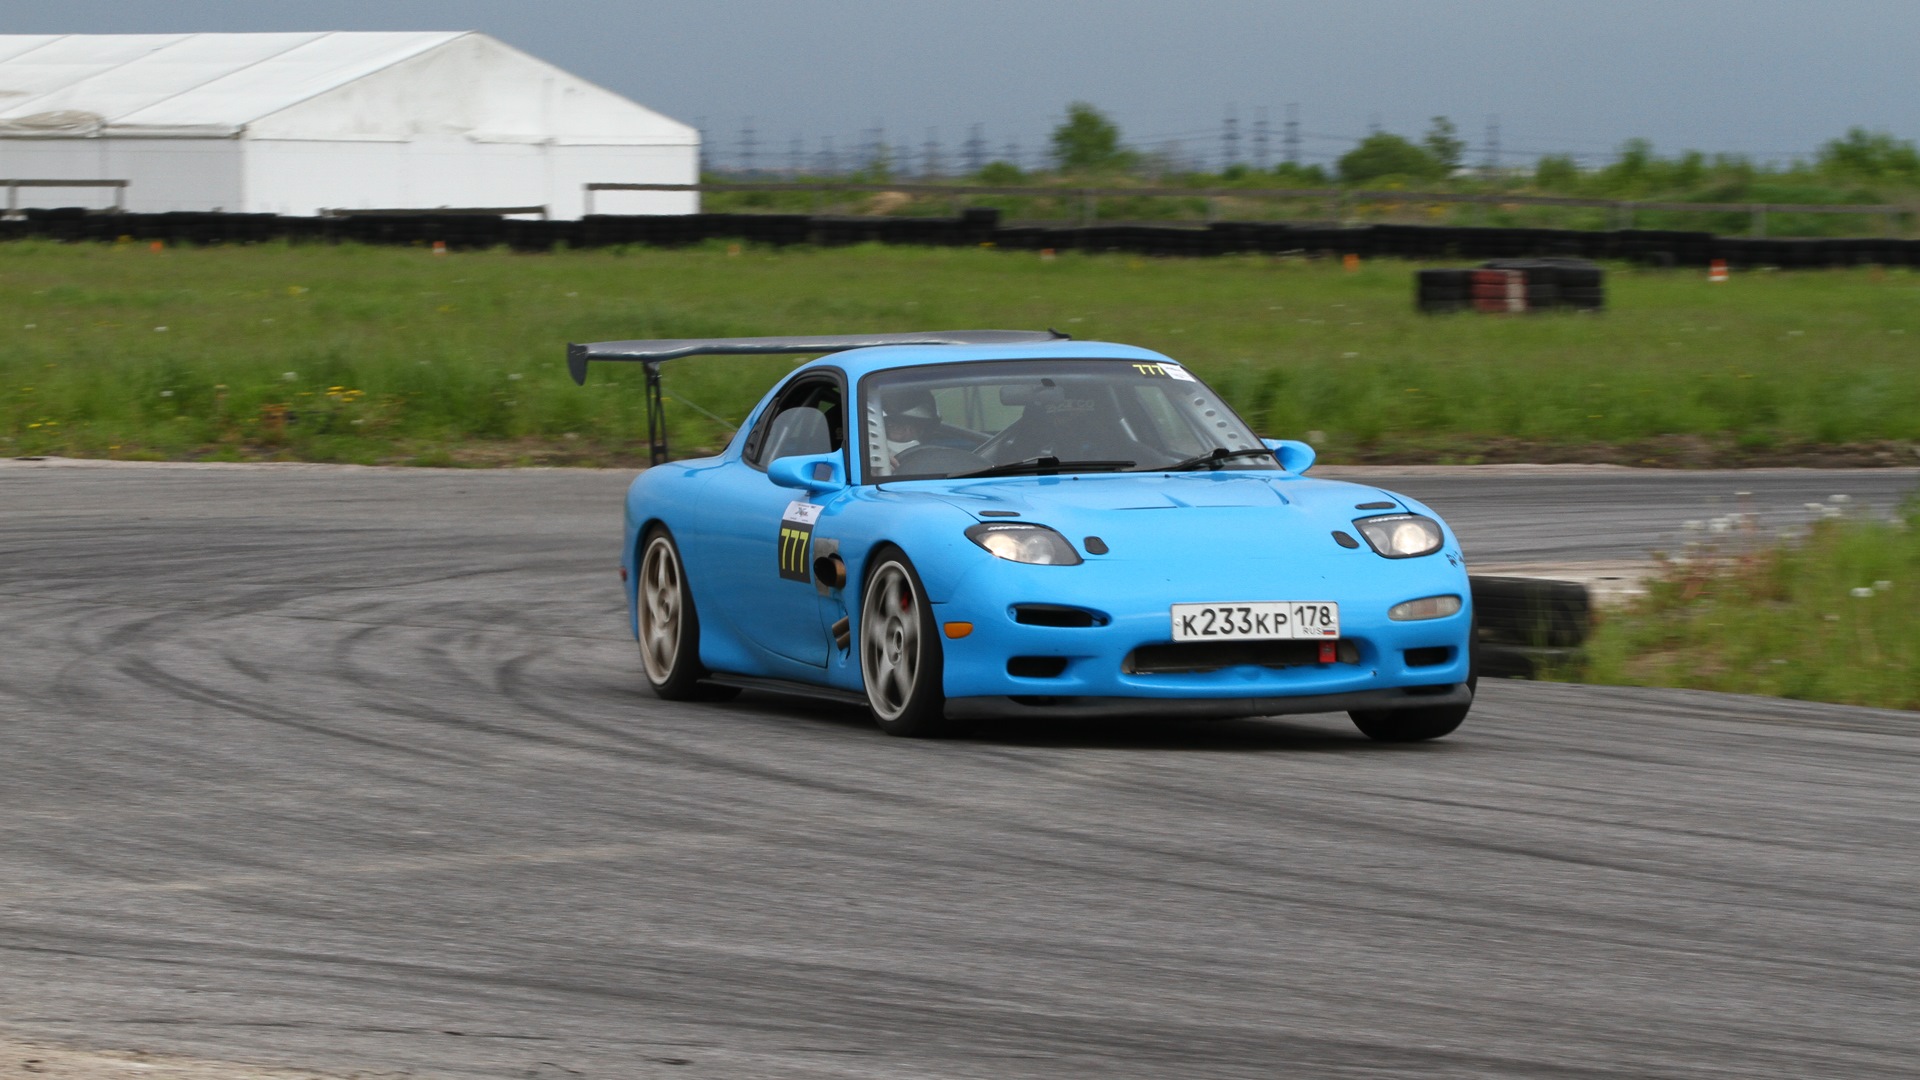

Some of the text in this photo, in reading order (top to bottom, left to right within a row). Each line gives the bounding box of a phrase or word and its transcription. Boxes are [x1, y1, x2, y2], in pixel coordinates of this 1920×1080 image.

[1132, 364, 1165, 375] 777
[781, 528, 809, 573] 777
[1294, 605, 1330, 626] 178
[1304, 627, 1322, 635] RUS
